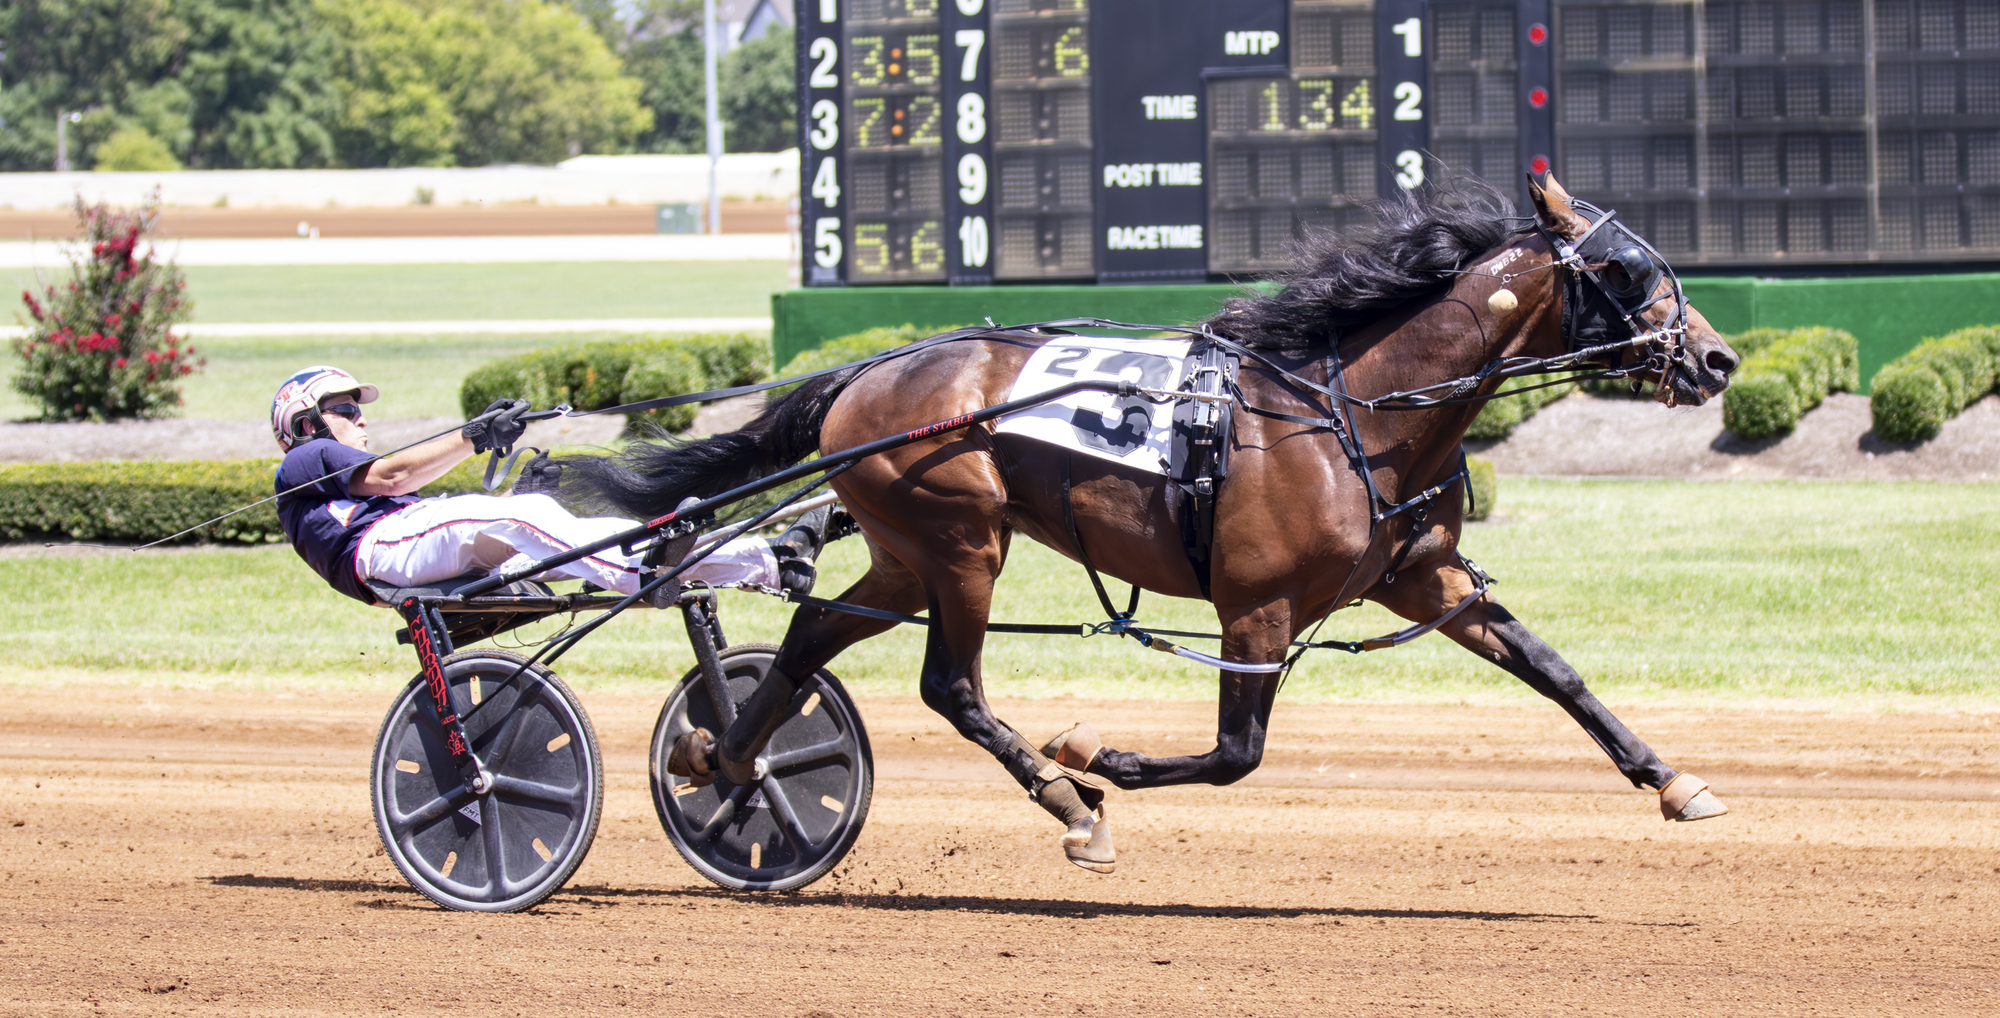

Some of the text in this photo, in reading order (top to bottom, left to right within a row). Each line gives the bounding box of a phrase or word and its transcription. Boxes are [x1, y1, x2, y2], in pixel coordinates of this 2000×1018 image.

[956, 29, 985, 81] 7
[1055, 27, 1089, 76] 6
[1225, 31, 1280, 54] MTP
[1393, 18, 1422, 56] 1
[809, 37, 838, 88] 2
[810, 99, 839, 150] 3
[957, 92, 986, 143] 8
[1142, 95, 1197, 119] TIME
[1394, 82, 1422, 120] 2
[812, 156, 840, 208] 4
[957, 153, 987, 205] 9
[1104, 162, 1202, 188] POST TIME
[1396, 150, 1424, 189] 3
[814, 217, 843, 268] 5
[959, 216, 988, 267] 10
[1044, 347, 1092, 377] 2
[906, 413, 975, 440] THE STABLE
[1067, 351, 1174, 458] 3
[462, 806, 480, 818] FMT
